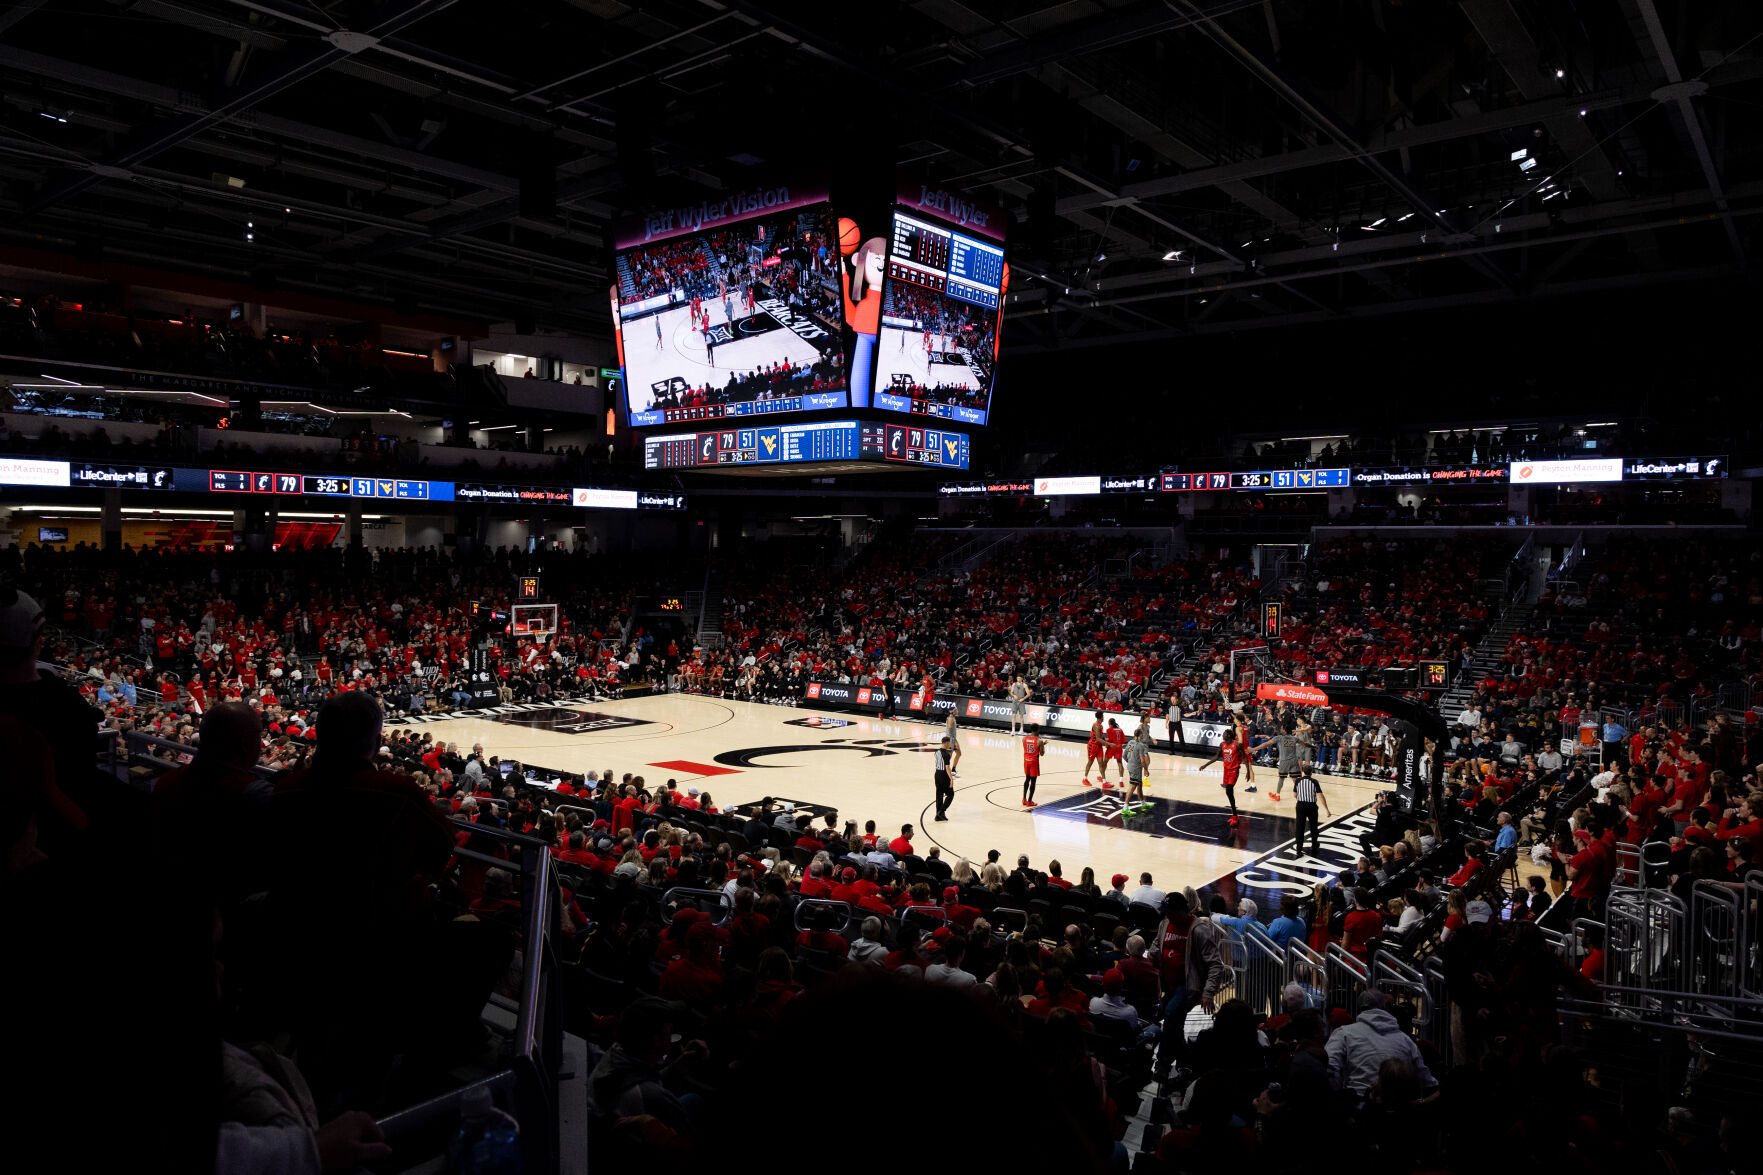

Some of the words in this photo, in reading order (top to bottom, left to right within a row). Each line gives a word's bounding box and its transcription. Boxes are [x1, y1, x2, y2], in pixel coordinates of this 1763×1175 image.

[918, 185, 948, 211] Jeff
[949, 195, 990, 227] Wyler
[644, 208, 674, 240] Jeff
[676, 200, 727, 231] Wyler
[727, 186, 790, 216] Vision
[818, 394, 838, 407] Kroger
[723, 433, 733, 449] 79
[742, 432, 752, 447] 51
[911, 430, 921, 446] 79
[928, 433, 937, 448] 51
[1573, 464, 1613, 473] Manning
[1631, 464, 1677, 474] LifeCenter
[80, 470, 127, 482] LifeCenter
[1213, 475, 1225, 487] 79
[1242, 474, 1260, 487] 3:25
[1278, 473, 1290, 485] 51
[1357, 473, 1383, 482] Organ
[1383, 472, 1422, 481] Donation
[1432, 471, 1467, 480] CHANGING
[1469, 470, 1482, 478] THE
[281, 476, 296, 492] 79
[317, 479, 338, 492] 3:25
[358, 480, 371, 495] 51
[459, 489, 481, 498] Organ
[482, 489, 512, 498] Donation
[525, 586, 534, 596] 14
[1269, 617, 1276, 633] 14
[1428, 664, 1445, 674] 3:25
[1330, 674, 1358, 682] TOYOTA
[1431, 674, 1442, 684] 14
[821, 687, 849, 698] TOYOTA
[931, 699, 957, 710] OYOTA
[983, 704, 1013, 716] TOYOT
[1026, 743, 1035, 753] 15
[1402, 748, 1414, 790] Ameritas
